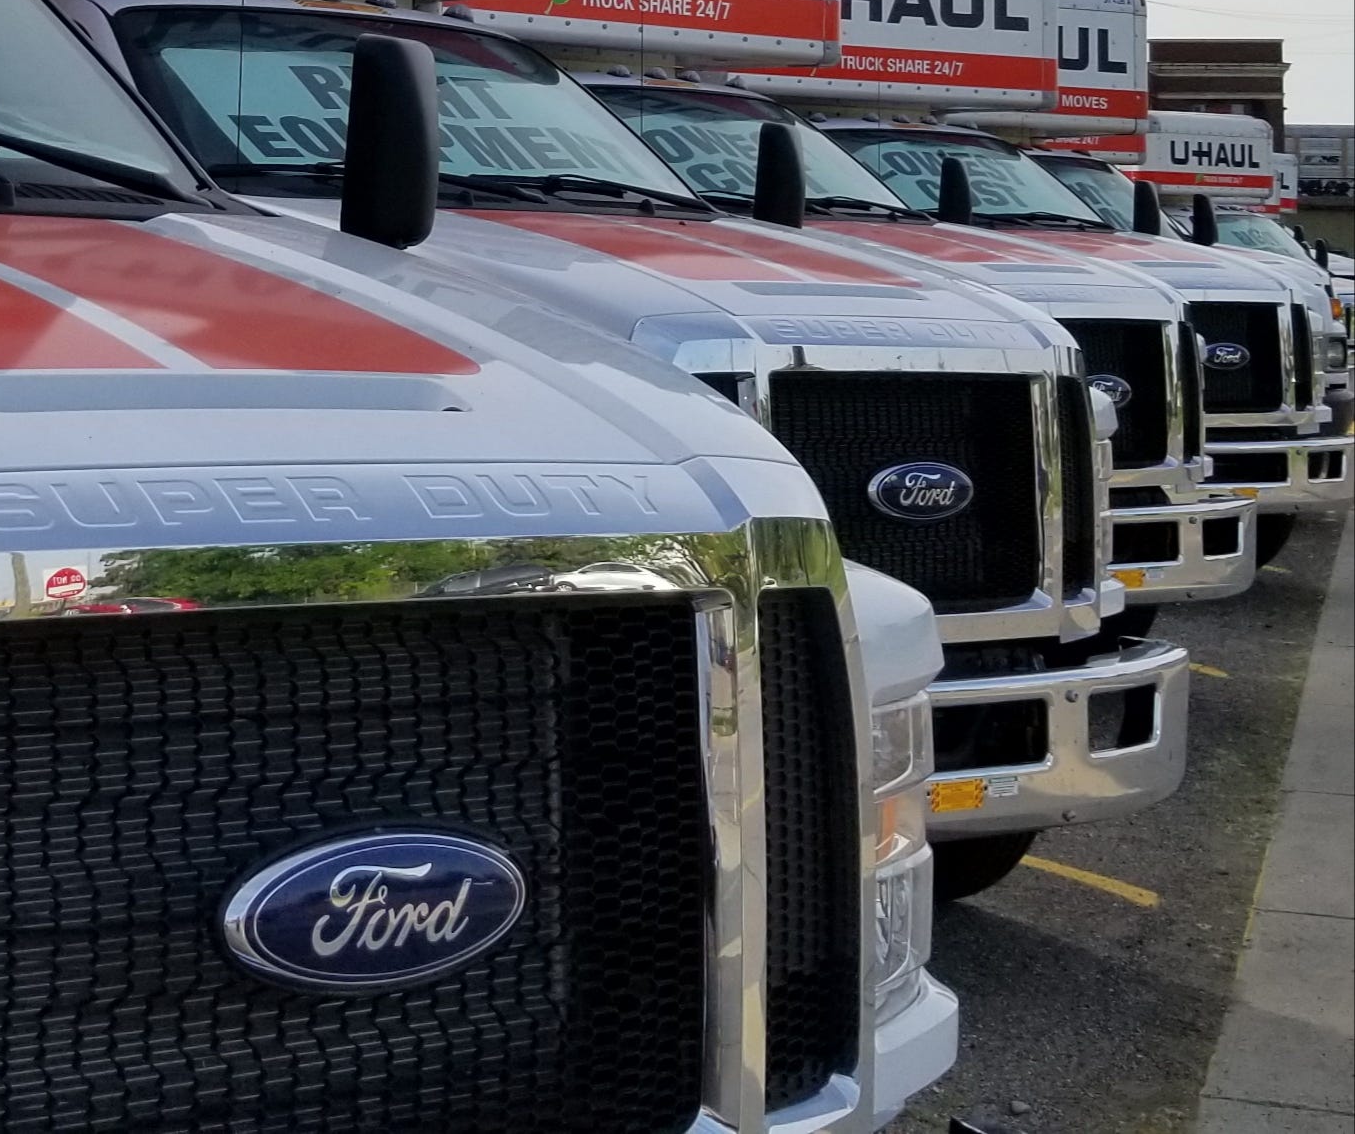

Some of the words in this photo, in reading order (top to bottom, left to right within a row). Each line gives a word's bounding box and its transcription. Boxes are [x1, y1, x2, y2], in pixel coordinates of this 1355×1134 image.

[696, 0, 730, 20] 24/7
[840, 55, 884, 72] TRUCK
[887, 58, 932, 74] SHARE
[934, 61, 964, 77] 24/7
[1061, 94, 1108, 110] MOVES
[404, 474, 659, 519] DUTY
[900, 472, 956, 507] Ford
[312, 863, 469, 957] Ford
